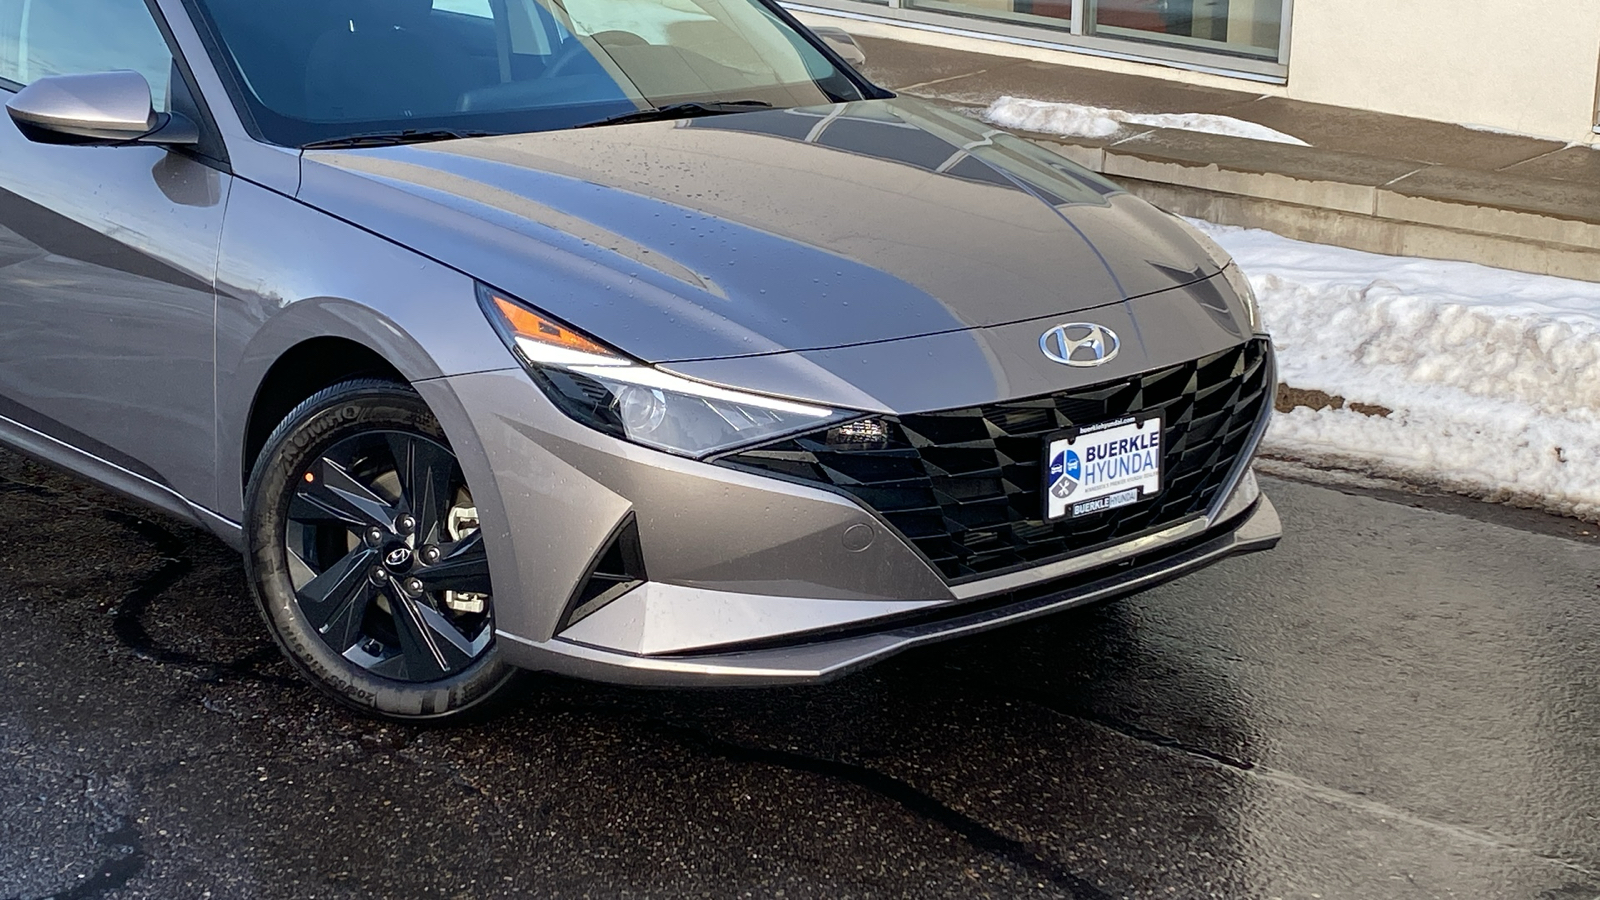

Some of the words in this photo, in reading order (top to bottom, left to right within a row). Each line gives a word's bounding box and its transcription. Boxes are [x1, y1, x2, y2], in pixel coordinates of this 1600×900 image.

[1086, 431, 1159, 463] BUERKLE
[1085, 448, 1159, 486] HYUNDAI
[1074, 497, 1110, 515] BUERKLE
[1110, 489, 1136, 505] HYUNDAI
